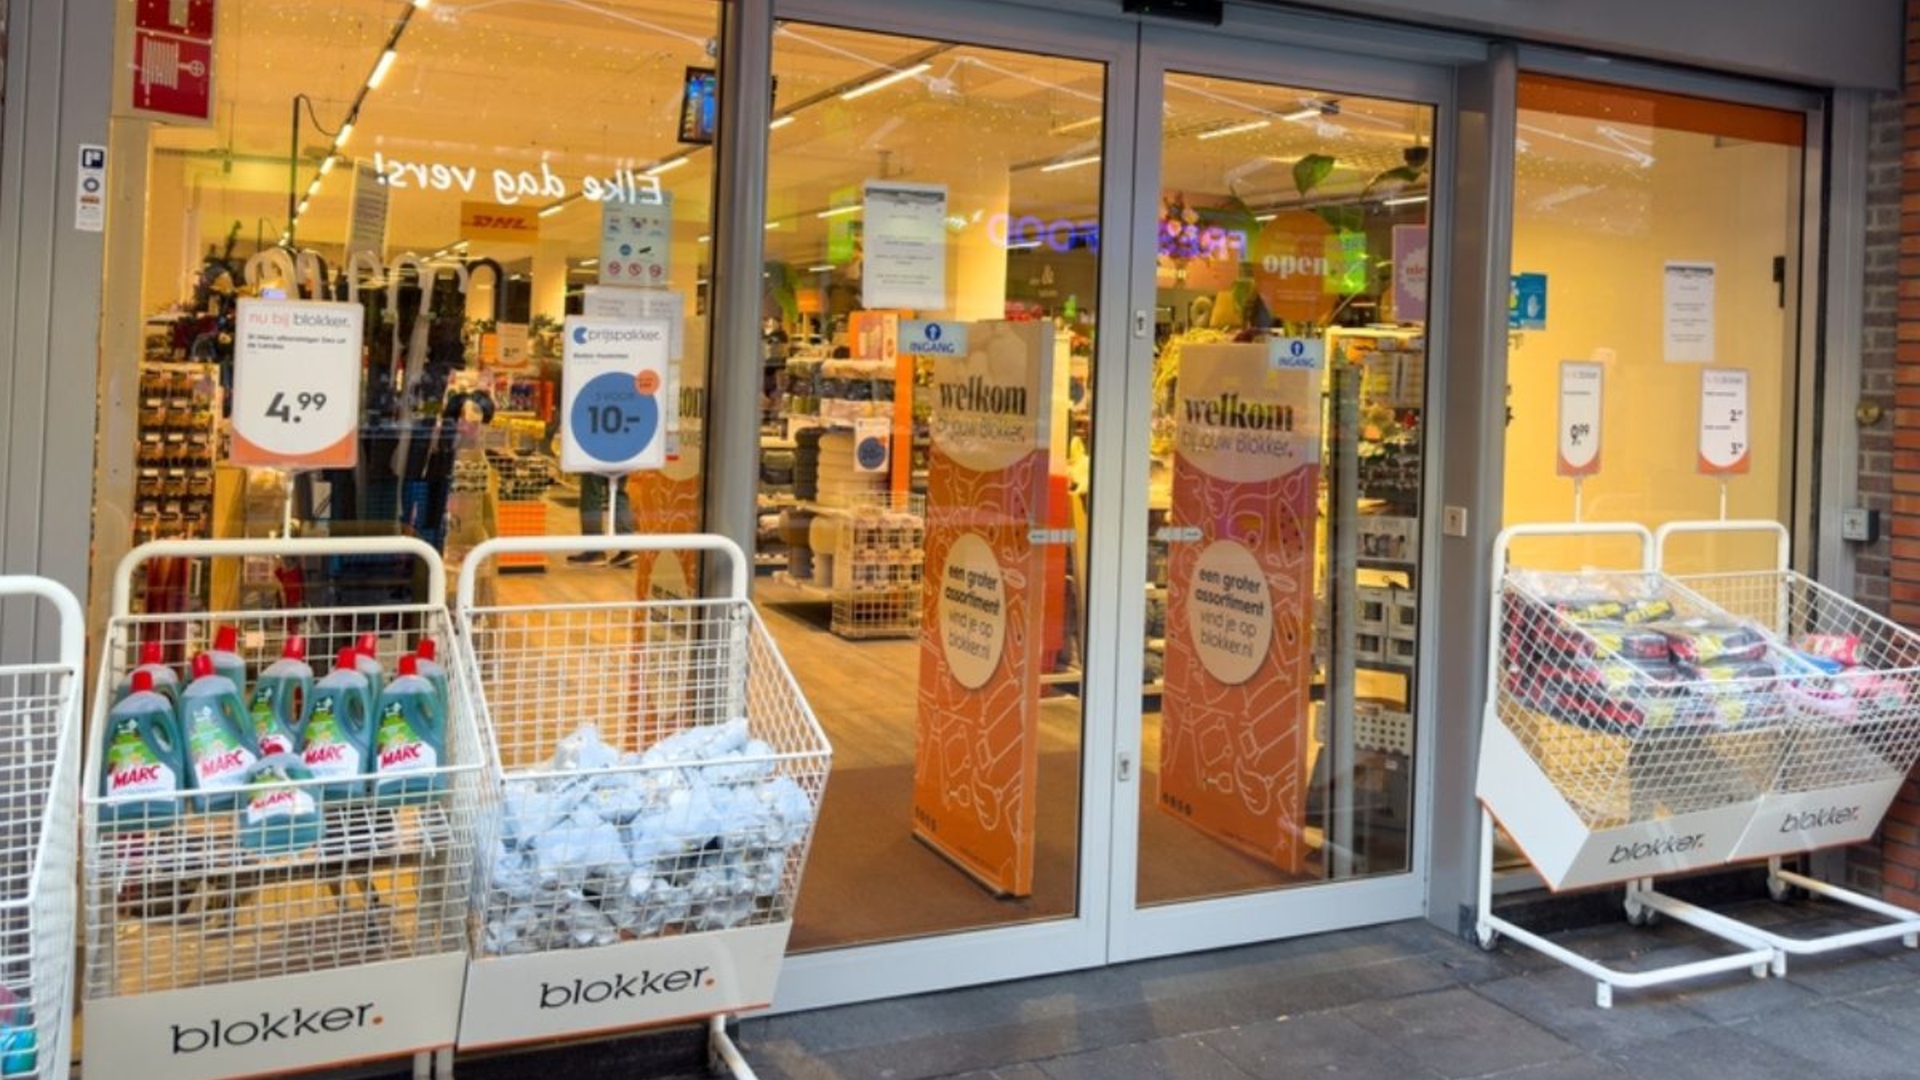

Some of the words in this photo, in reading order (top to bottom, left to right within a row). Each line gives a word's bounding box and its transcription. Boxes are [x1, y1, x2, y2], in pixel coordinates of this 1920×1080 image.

[472, 214, 528, 230] DHL
[1262, 253, 1328, 280] open
[909, 341, 955, 354] INGANG
[1278, 356, 1316, 368] INGANG
[264, 391, 327, 424] 4.99
[940, 373, 1028, 416] welkom
[1184, 391, 1294, 431] welkom
[948, 565, 965, 582] een
[966, 570, 999, 591] groter
[1199, 568, 1220, 583] een
[1222, 573, 1261, 594] groter
[944, 586, 1000, 616] assortiment
[1195, 588, 1265, 617] assortiment
[202, 750, 244, 779] MARC
[304, 745, 347, 766] MARC
[382, 742, 423, 768] MARC
[112, 764, 161, 789] MARC
[1779, 805, 1860, 833] blokker.
[1609, 831, 1704, 864] blokker.
[540, 966, 716, 1010] blokker.
[171, 1002, 385, 1055] blokker.
